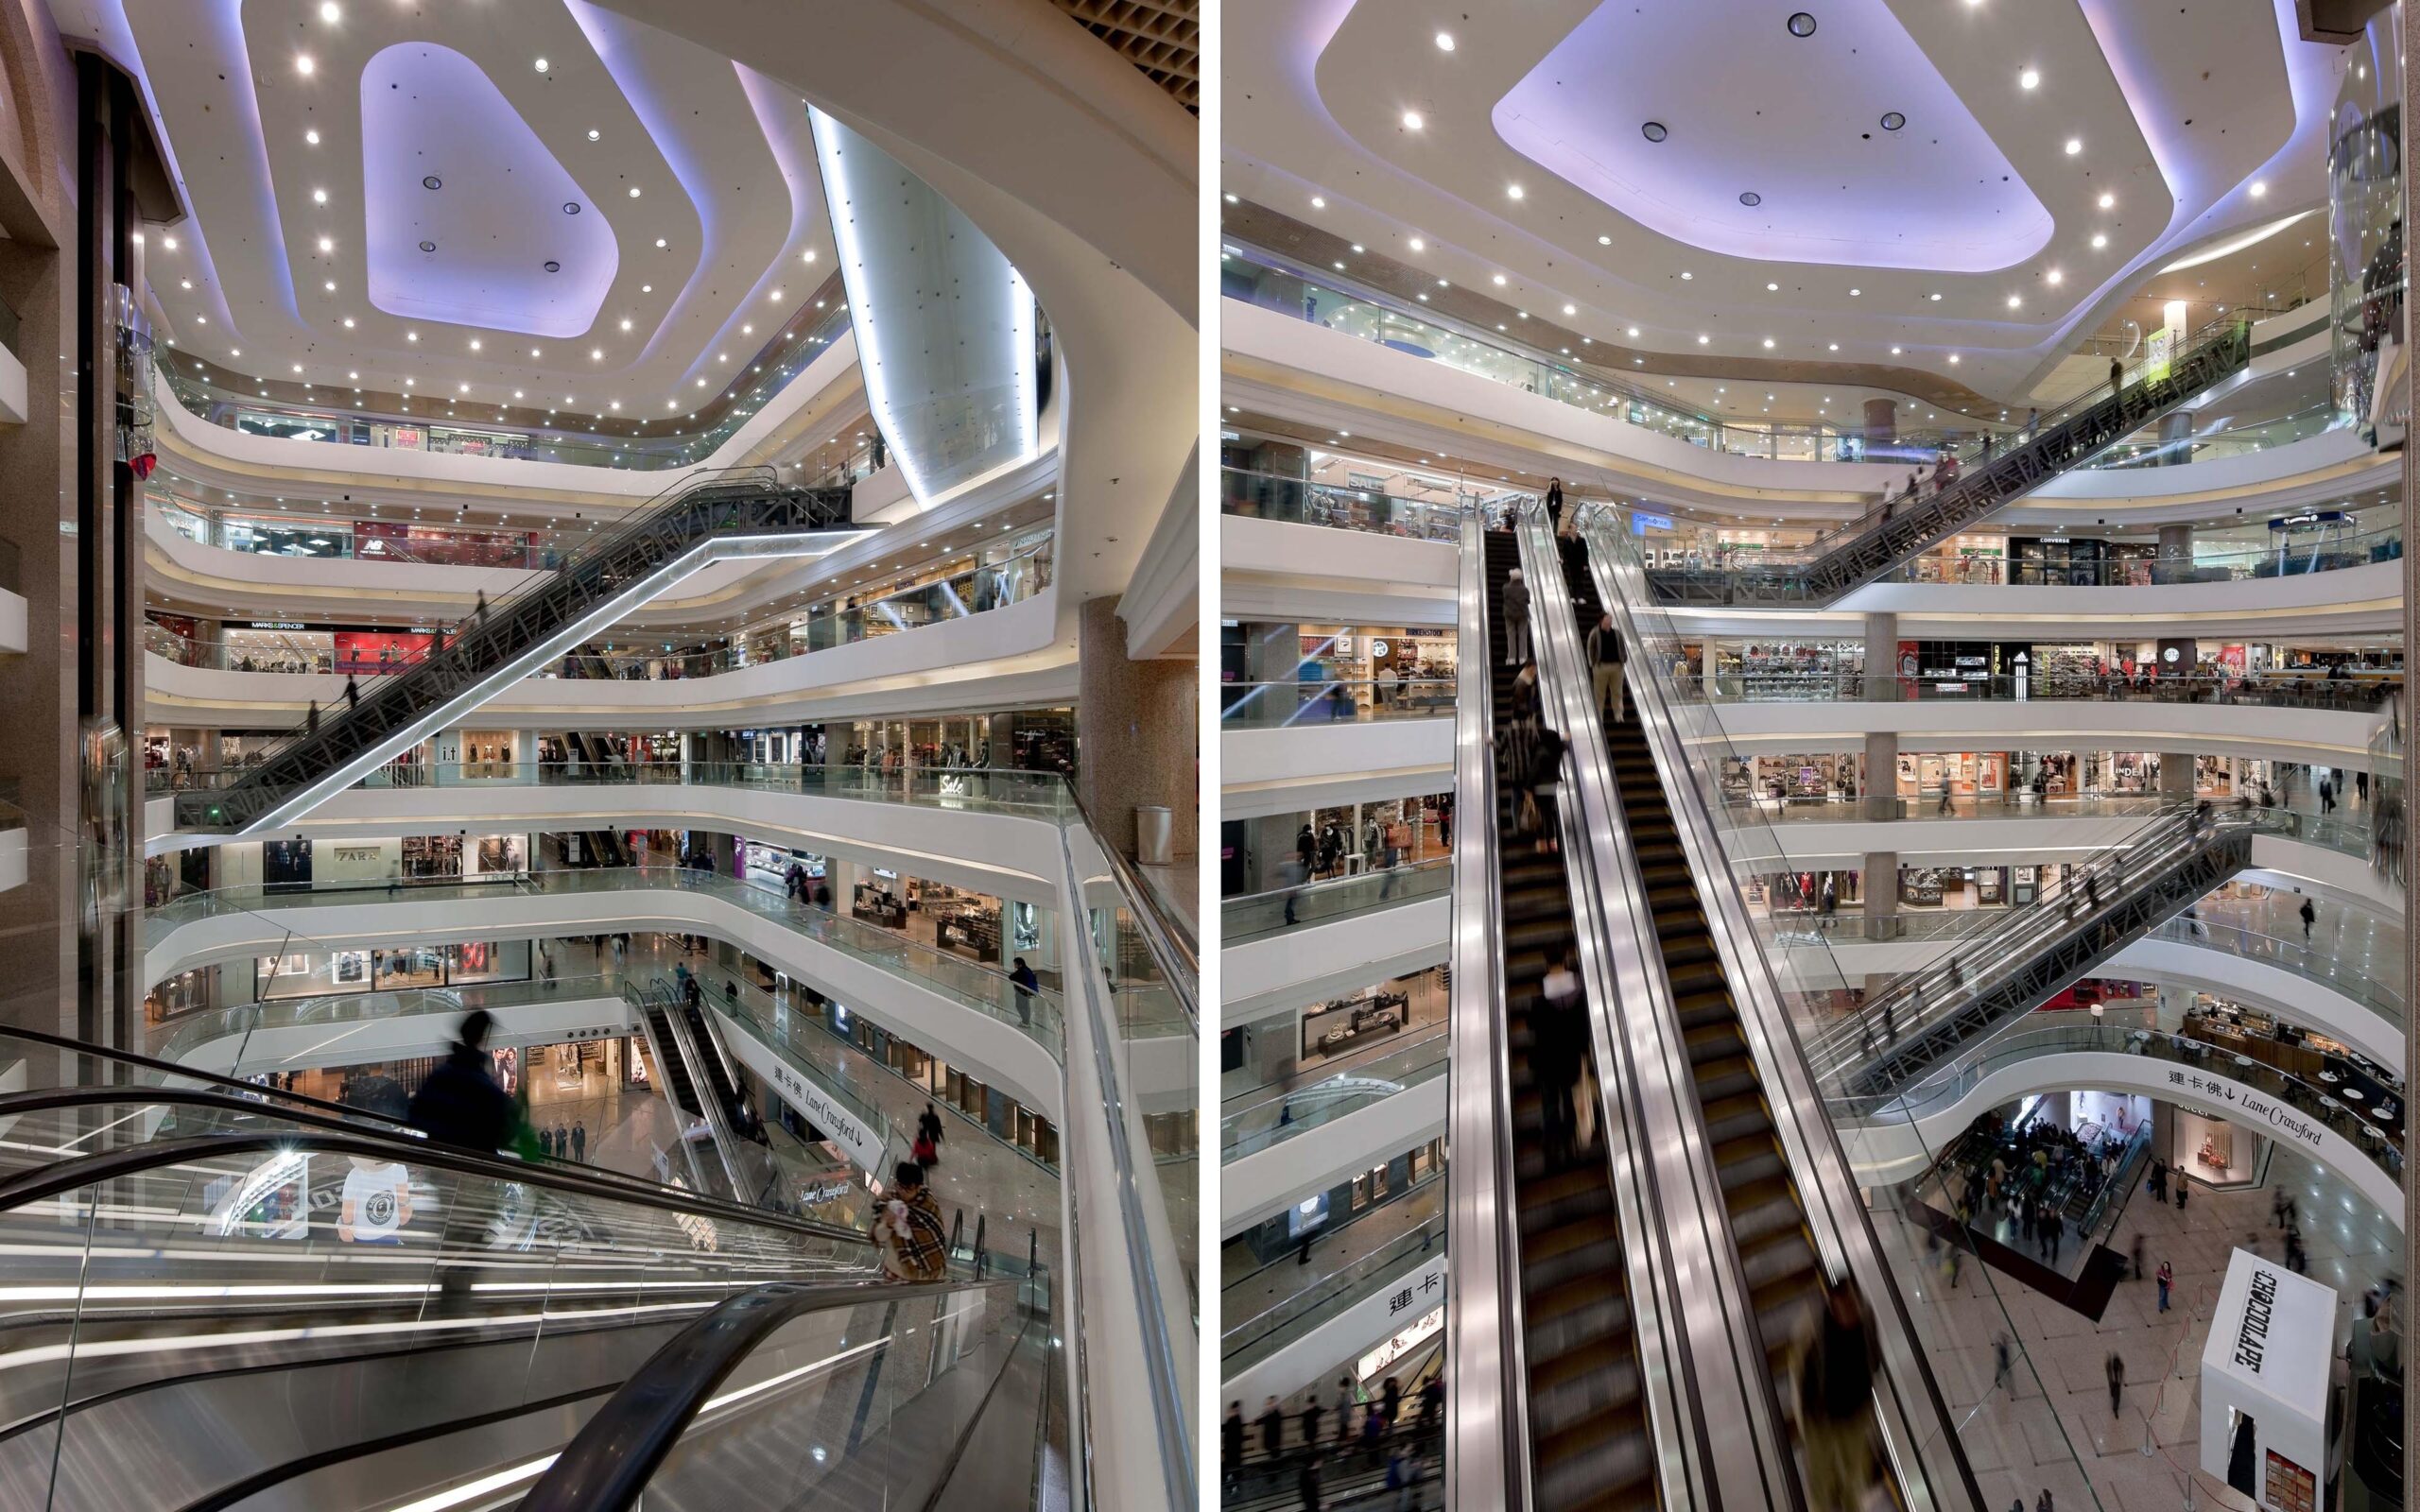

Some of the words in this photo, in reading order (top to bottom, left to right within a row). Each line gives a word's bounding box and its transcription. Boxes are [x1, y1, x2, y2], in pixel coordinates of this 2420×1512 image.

[941, 775, 963, 795] Sale
[337, 851, 377, 862] ZARA
[774, 1065, 802, 1098] 連卡佛
[805, 1090, 821, 1114] Lane
[821, 1102, 855, 1142] Crawford
[2169, 1070, 2222, 1097] 連卡佛
[2241, 1093, 2270, 1116] Lane
[2269, 1107, 2322, 1146] Crawford
[800, 1190, 816, 1202] Lane
[816, 1183, 849, 1202] Crawford
